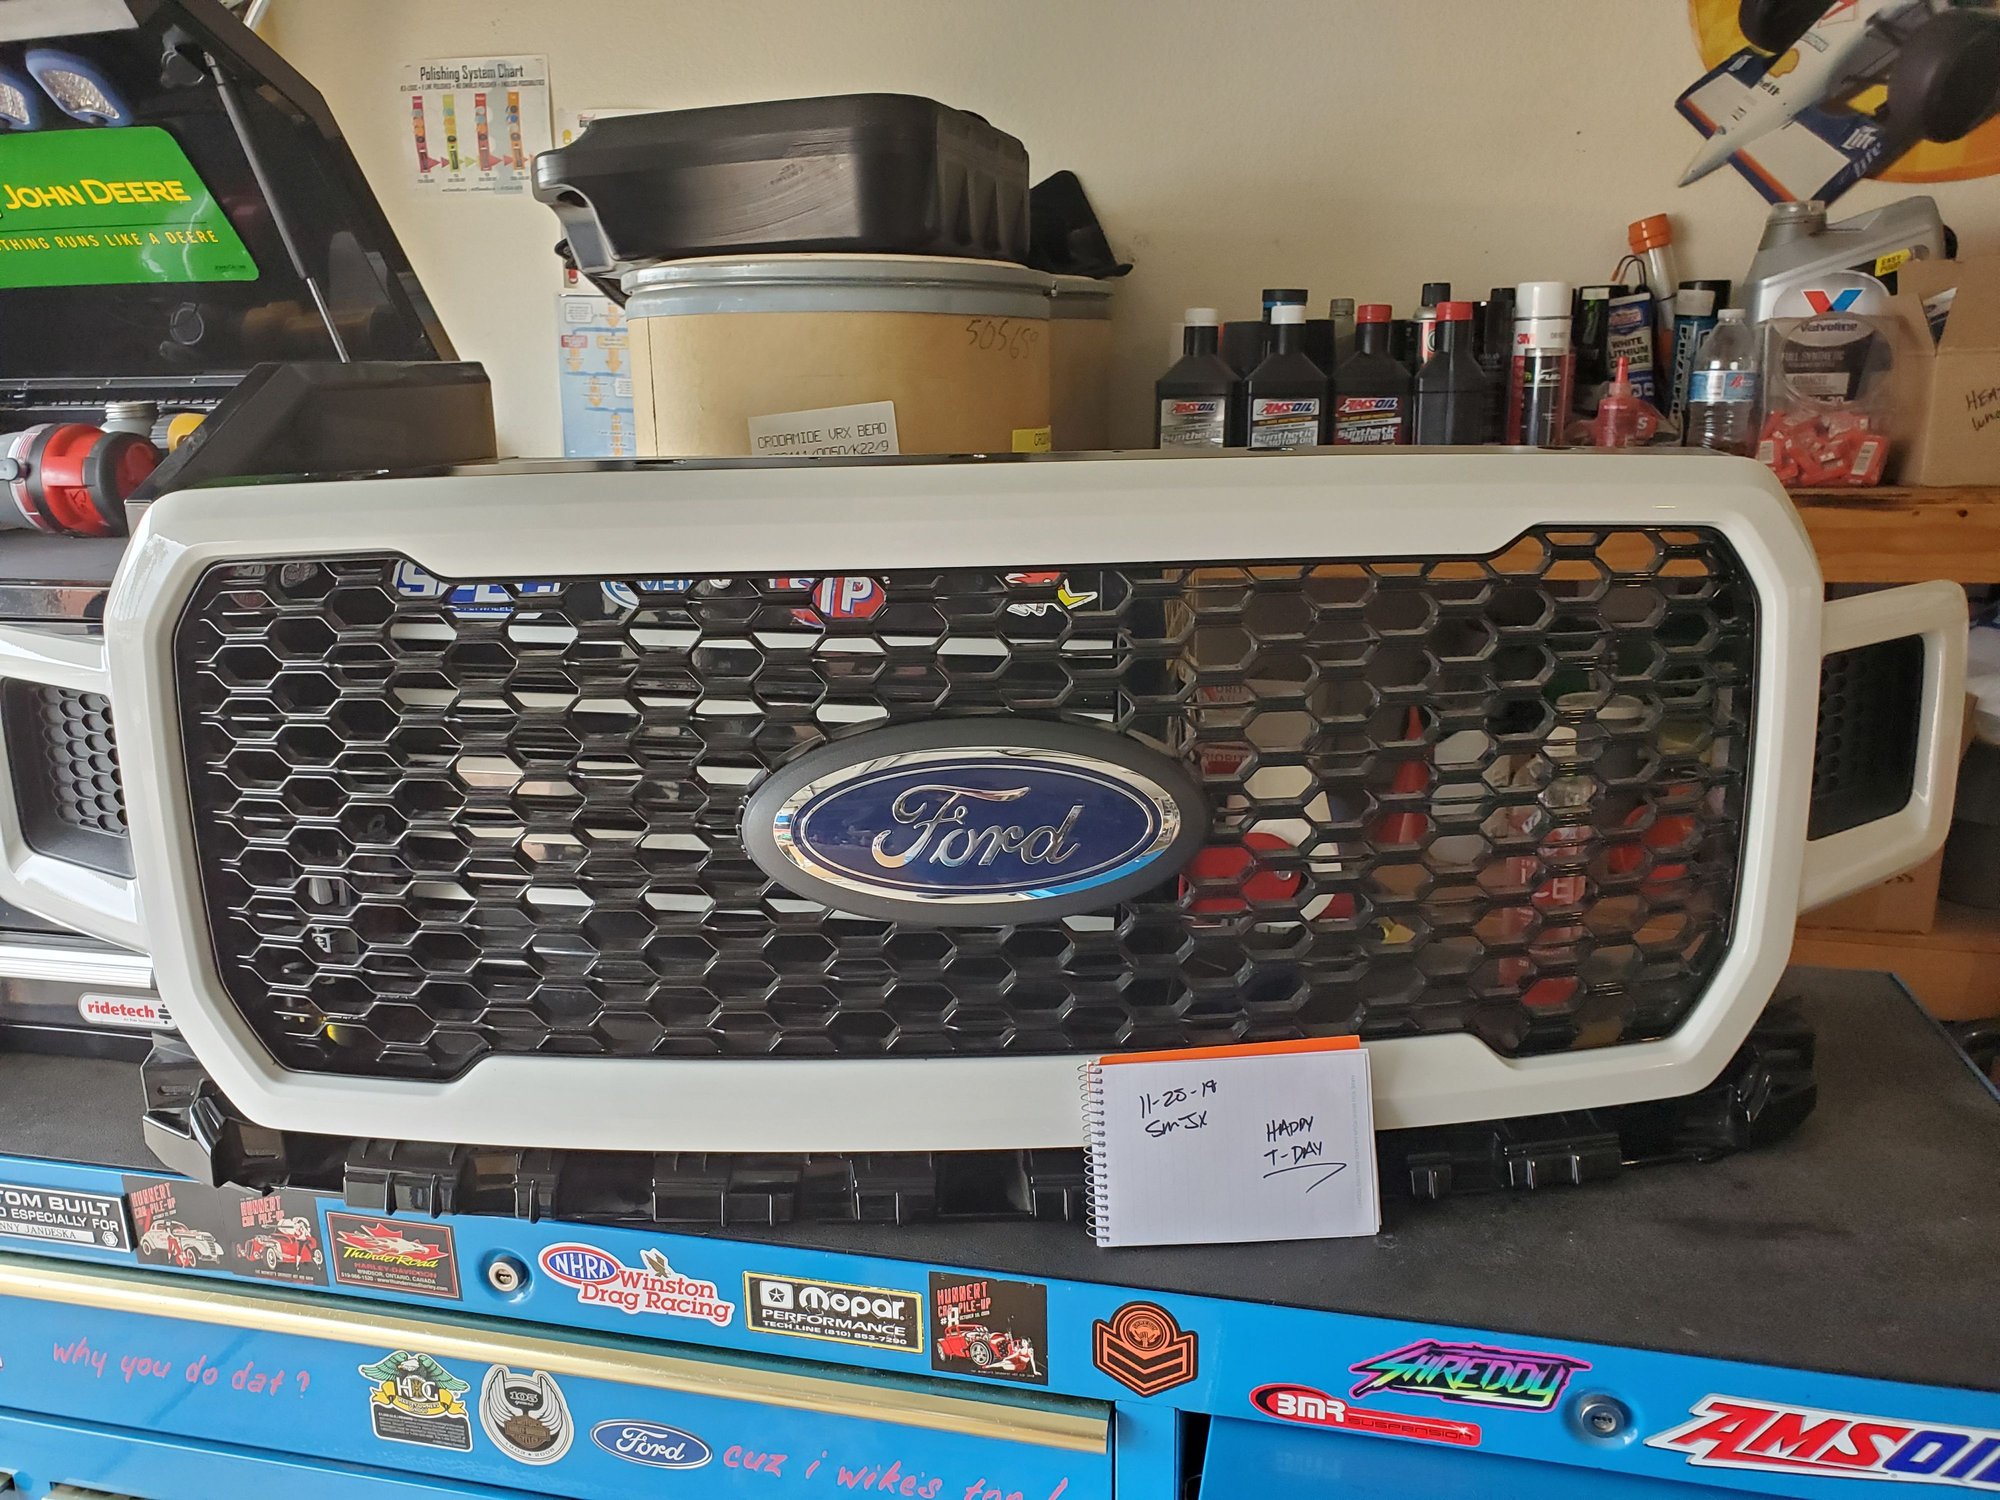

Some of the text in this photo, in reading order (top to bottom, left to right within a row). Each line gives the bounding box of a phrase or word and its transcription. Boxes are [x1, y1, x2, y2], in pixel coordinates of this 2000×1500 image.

[420, 63, 524, 83] Polishing System Chart
[3, 179, 192, 210] JOHN DEERE
[54, 234, 100, 249] RUNS
[104, 232, 143, 247] LIKE
[148, 232, 161, 245] A
[164, 230, 219, 244] DEERE
[1800, 323, 1858, 333] Valvoline
[1609, 345, 1649, 359] LITHIUM
[1611, 337, 1643, 349] WHITE
[1610, 354, 1650, 368] GASE
[1169, 402, 1216, 415] AMSOIL
[1339, 398, 1398, 412] AMSOIL
[1966, 387, 2000, 410] HEA
[1257, 402, 1314, 416] AMSOIL
[757, 422, 887, 449] CRODAMIDE VRX BEAD
[871, 784, 1086, 869] Ford
[88, 1001, 155, 1018] ridetech
[1263, 1141, 1323, 1166] T-DAY
[48, 1196, 110, 1216] BUILT
[11, 1209, 87, 1227] ESPECIALLY
[92, 1219, 119, 1231] FOR
[25, 1225, 77, 1240] JANDESKA
[354, 1262, 437, 1279] HARLEY-DAVIDSON
[555, 1253, 610, 1279] NHRA
[412, 1275, 436, 1284] CANADA
[619, 1270, 714, 1298] Winston
[582, 1282, 731, 1322] Drag Racing
[958, 1297, 991, 1314] PILE-UP
[762, 1309, 906, 1336] PERFORMANCE
[824, 1328, 851, 1338] (810)
[854, 1332, 907, 1345] 853-7290
[53, 1336, 311, 1399] why you do dat ?
[1357, 1347, 1571, 1408] SHREDDY
[509, 1391, 538, 1403] 105
[1277, 1393, 1346, 1423] BMR
[1348, 1416, 1473, 1441] SUSPENSION
[615, 1427, 687, 1462] Ford
[723, 1445, 788, 1479] cuz
[804, 1451, 828, 1480] i
